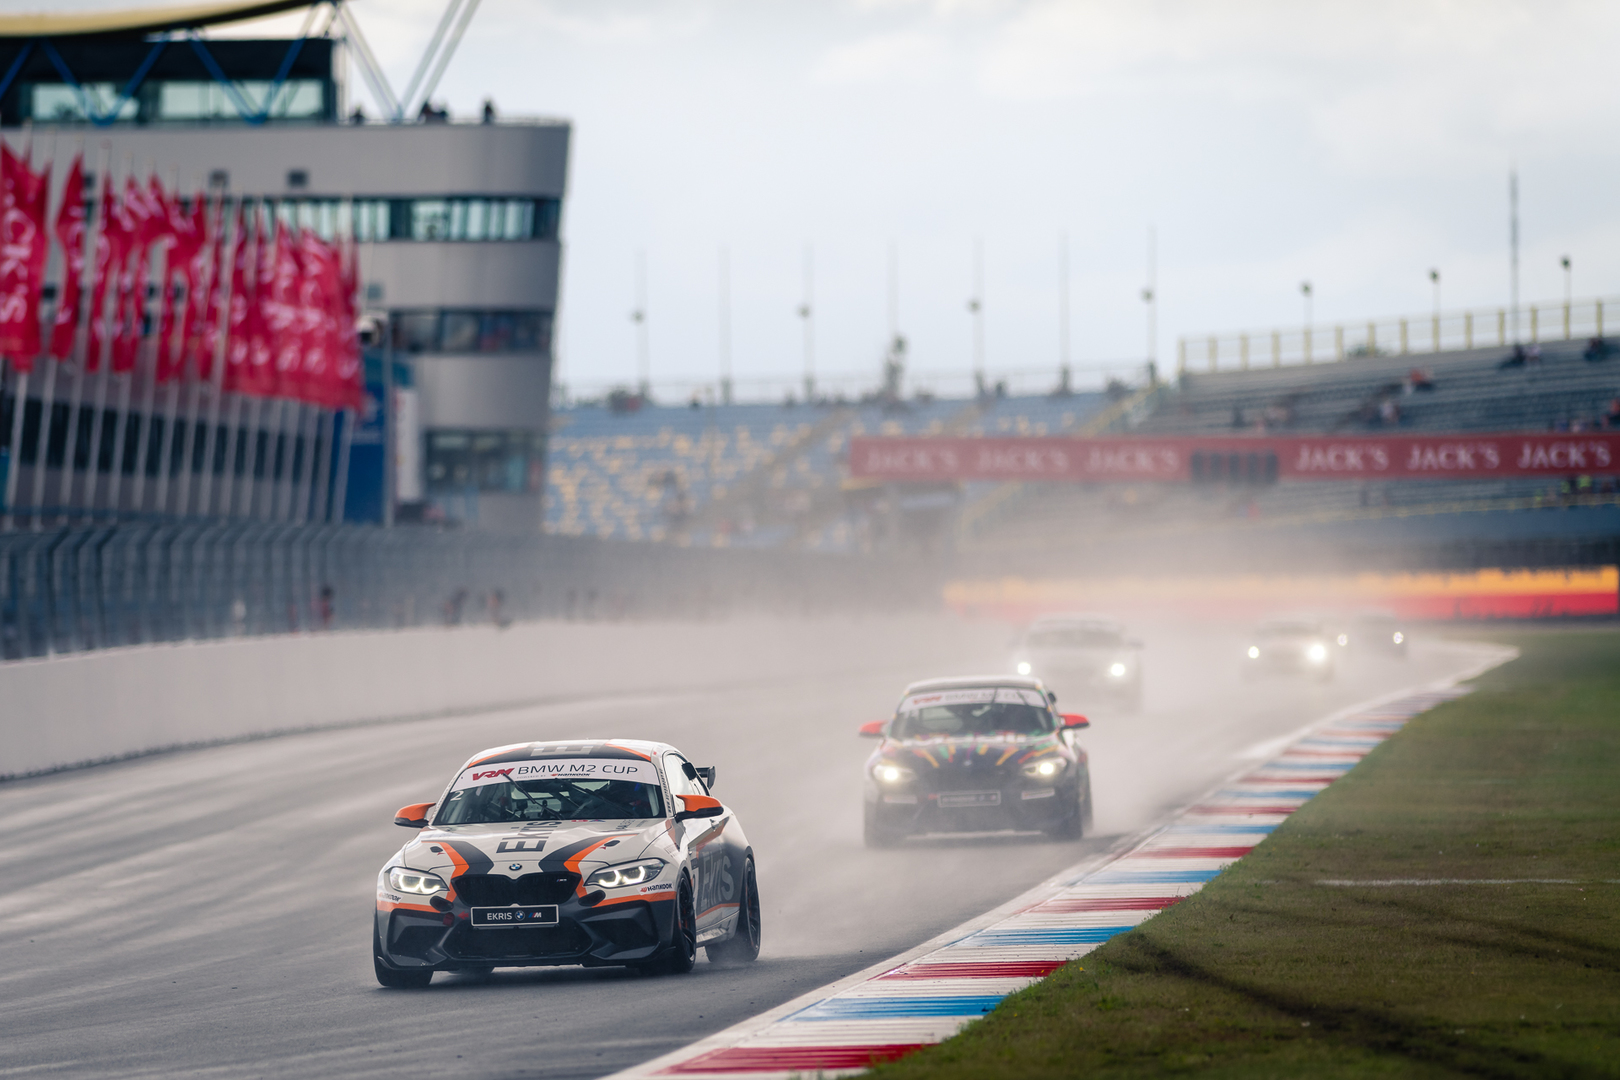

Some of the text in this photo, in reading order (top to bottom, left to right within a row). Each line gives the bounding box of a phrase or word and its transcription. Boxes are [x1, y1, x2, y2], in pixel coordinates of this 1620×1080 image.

[1295, 440, 1611, 472] JACK'S JACK'S JACK'S
[517, 764, 638, 775] BMW M2 CUP
[450, 790, 464, 801] 2
[487, 912, 512, 920] EKRIS
